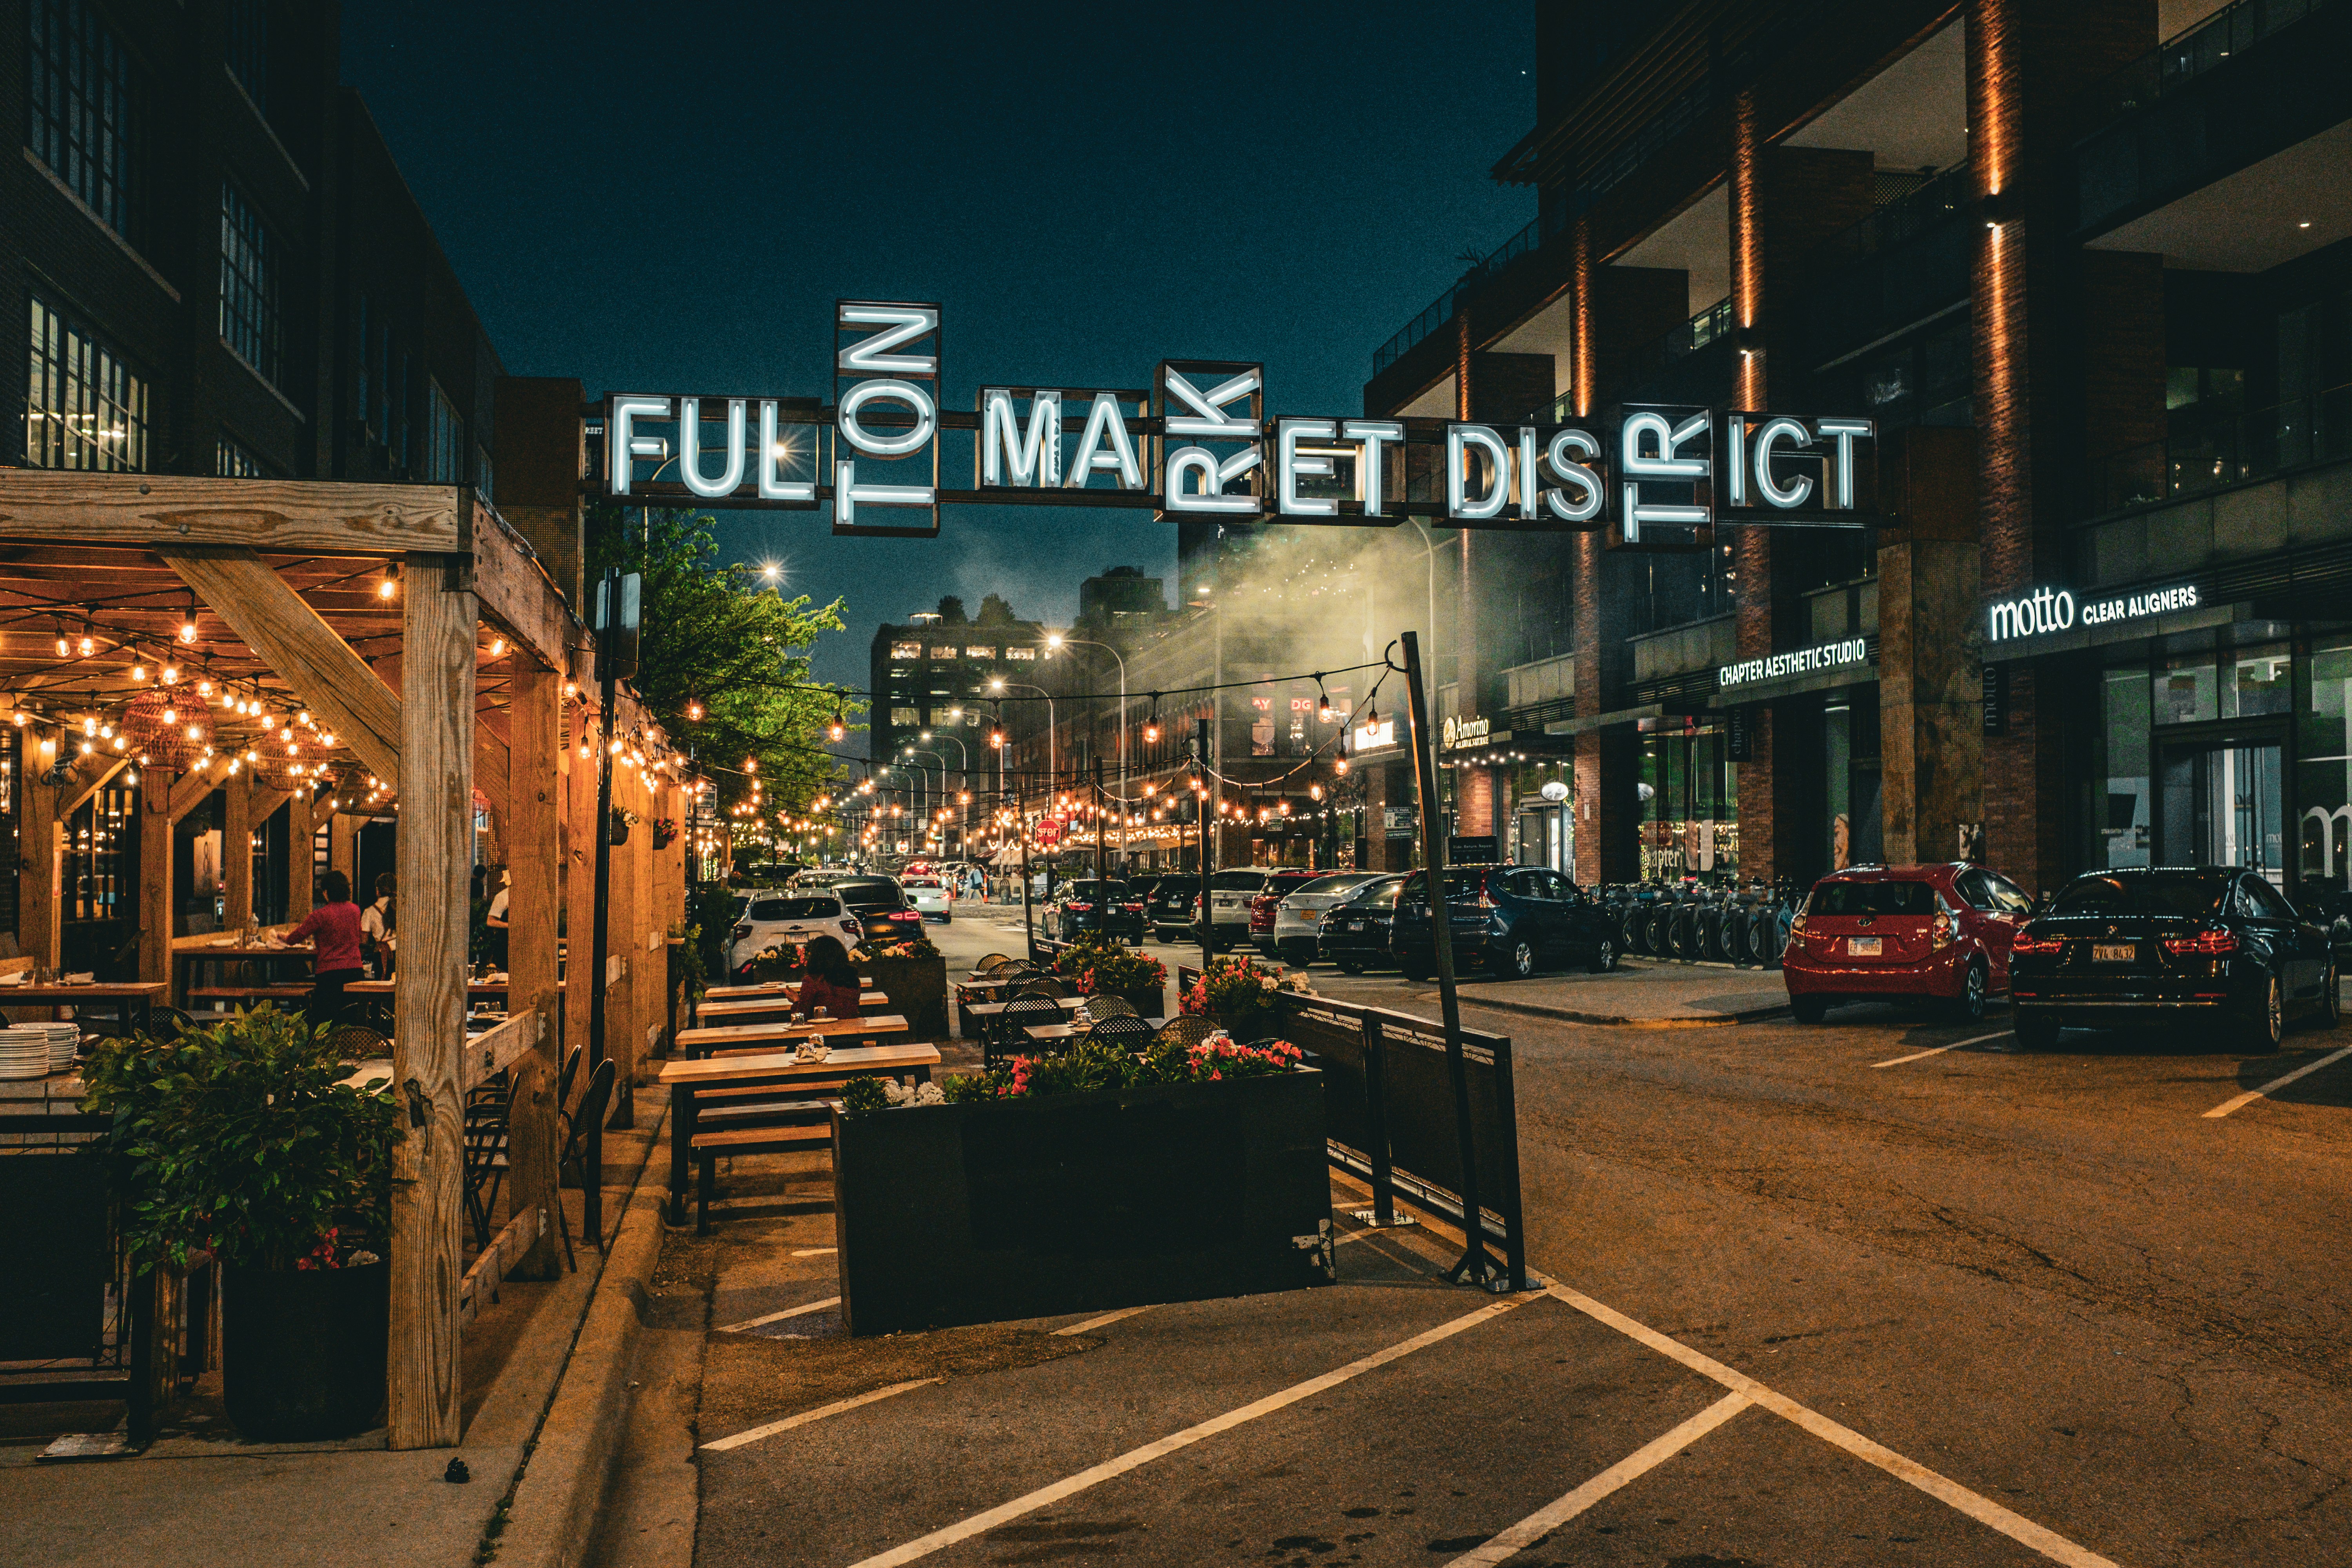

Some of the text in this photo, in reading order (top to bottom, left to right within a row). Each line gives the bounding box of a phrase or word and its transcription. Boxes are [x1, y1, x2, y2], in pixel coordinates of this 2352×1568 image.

[1991, 585, 2197, 641] motto CLEAR ALIGNERS
[1720, 638, 1865, 686] CHAPTER AESTHETIC STUDIO
[1292, 699, 1311, 710] DG
[1983, 667, 1997, 726] motto
[1455, 715, 1489, 740] Amorino
[1732, 709, 1744, 754] chapter
[1037, 828, 1059, 837] STOP
